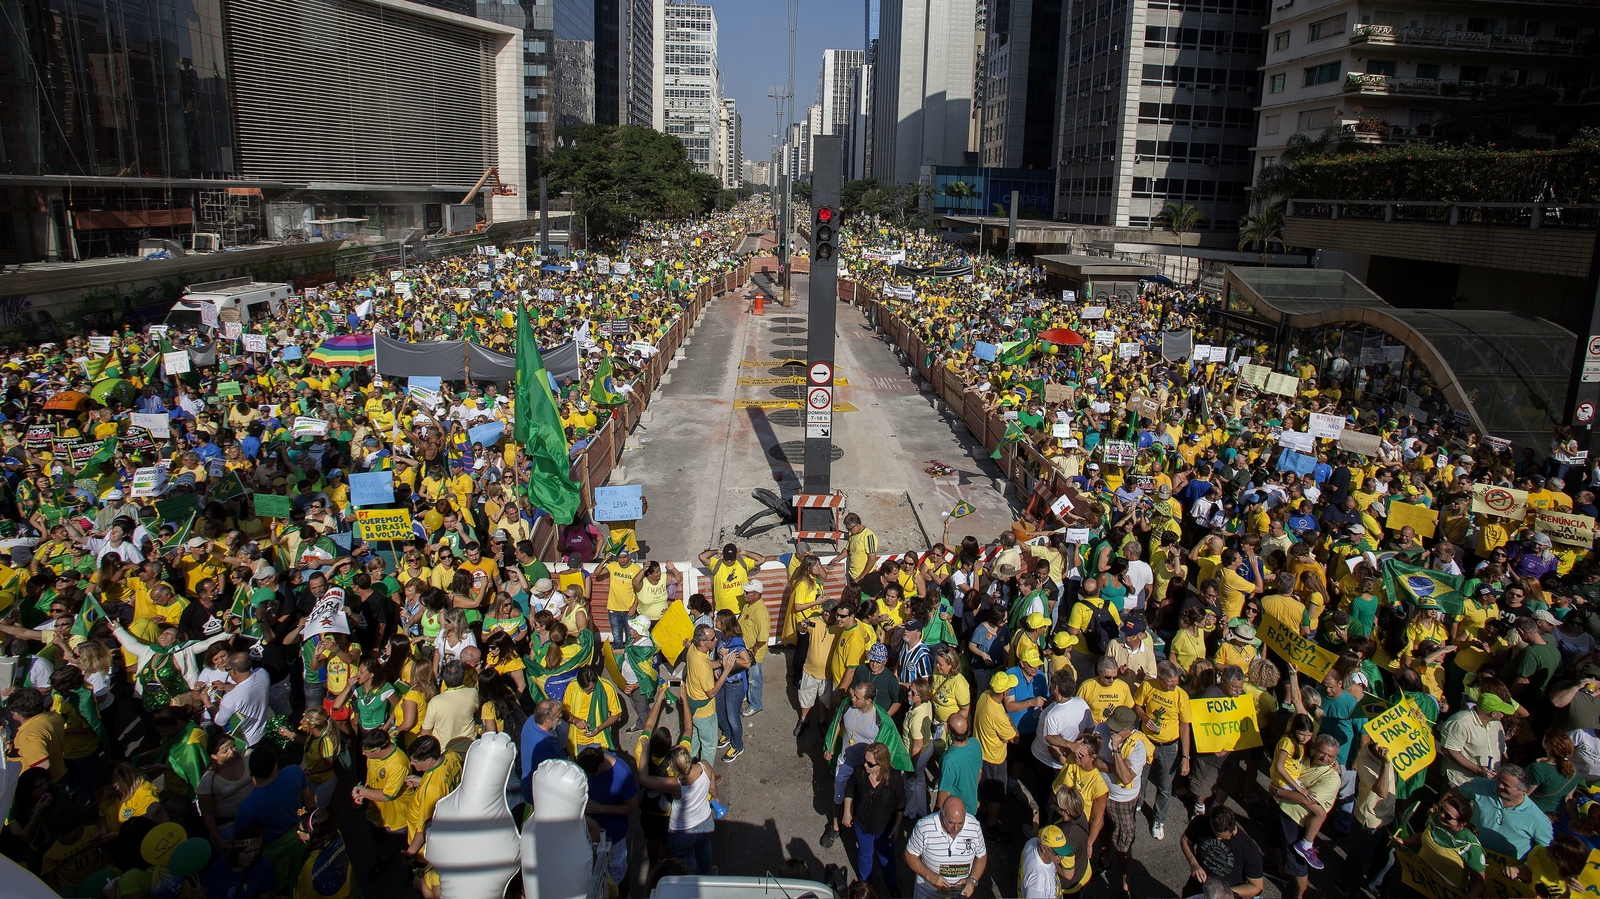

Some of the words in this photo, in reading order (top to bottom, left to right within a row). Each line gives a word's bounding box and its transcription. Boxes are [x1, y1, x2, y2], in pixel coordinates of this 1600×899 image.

[77, 444, 100, 453] FORA
[1479, 484, 1493, 498] FORA
[612, 500, 629, 508] LEVA
[1503, 502, 1520, 516] DILMA
[360, 515, 404, 525] QUEREMOS
[375, 521, 411, 531] BRASIL
[1541, 513, 1587, 529] RENÚNCIA
[614, 571, 633, 579] BRASIL
[1278, 623, 1317, 654] MUDA
[1266, 625, 1318, 669] BRASIL
[1206, 699, 1238, 713] FORA
[1371, 704, 1408, 732] CADEIA
[1380, 720, 1412, 744] PARA
[1408, 727, 1421, 741] OS
